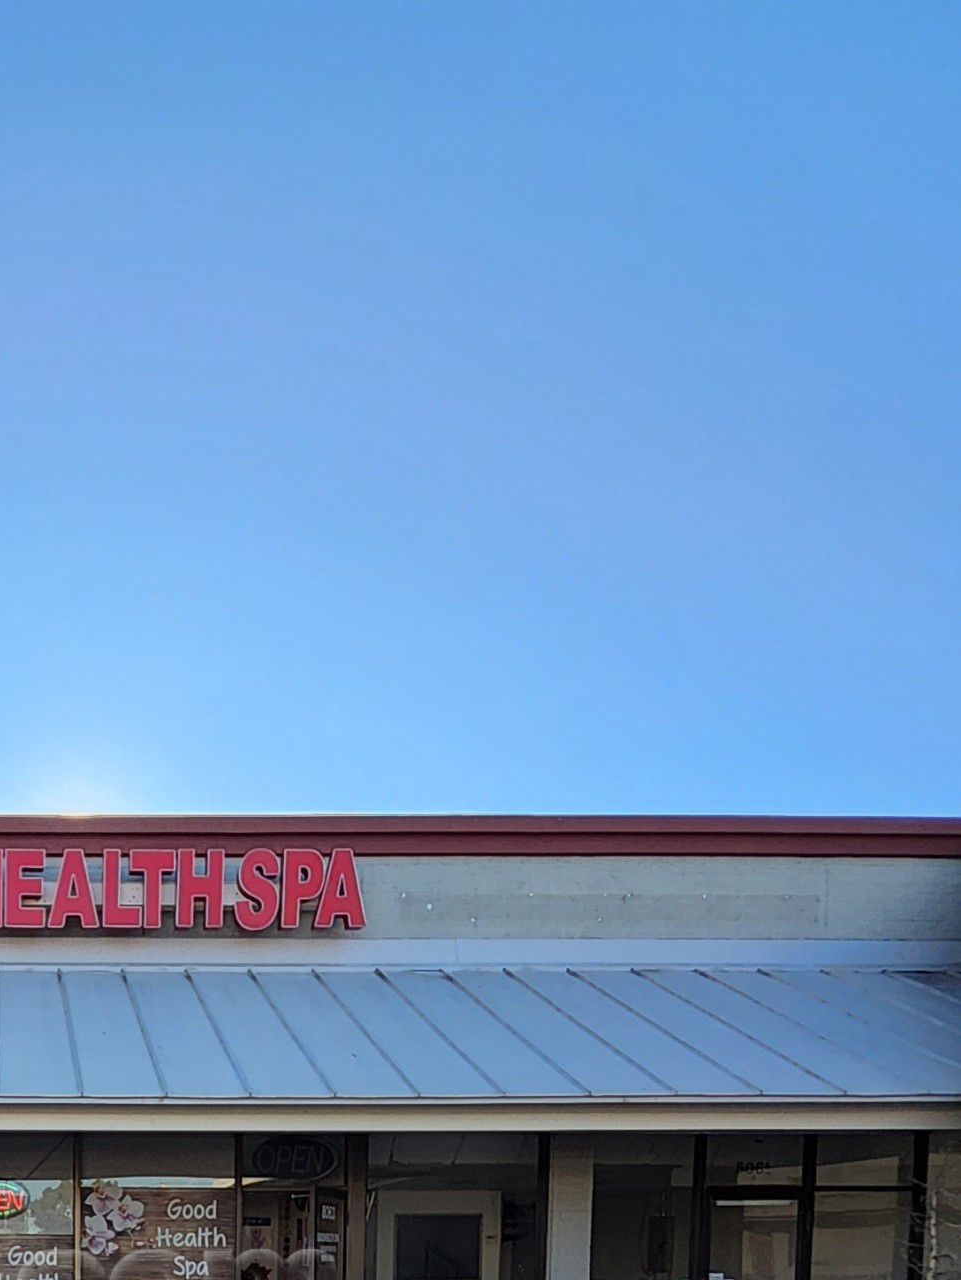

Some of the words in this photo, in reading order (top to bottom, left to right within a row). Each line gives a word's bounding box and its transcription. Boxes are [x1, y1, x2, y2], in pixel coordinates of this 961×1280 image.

[235, 847, 368, 931] SPA
[257, 1144, 325, 1174] OPEN
[167, 1199, 217, 1220] Good
[156, 1227, 227, 1248] Health
[7, 1245, 58, 1267] Good
[173, 1255, 209, 1279] Spa
